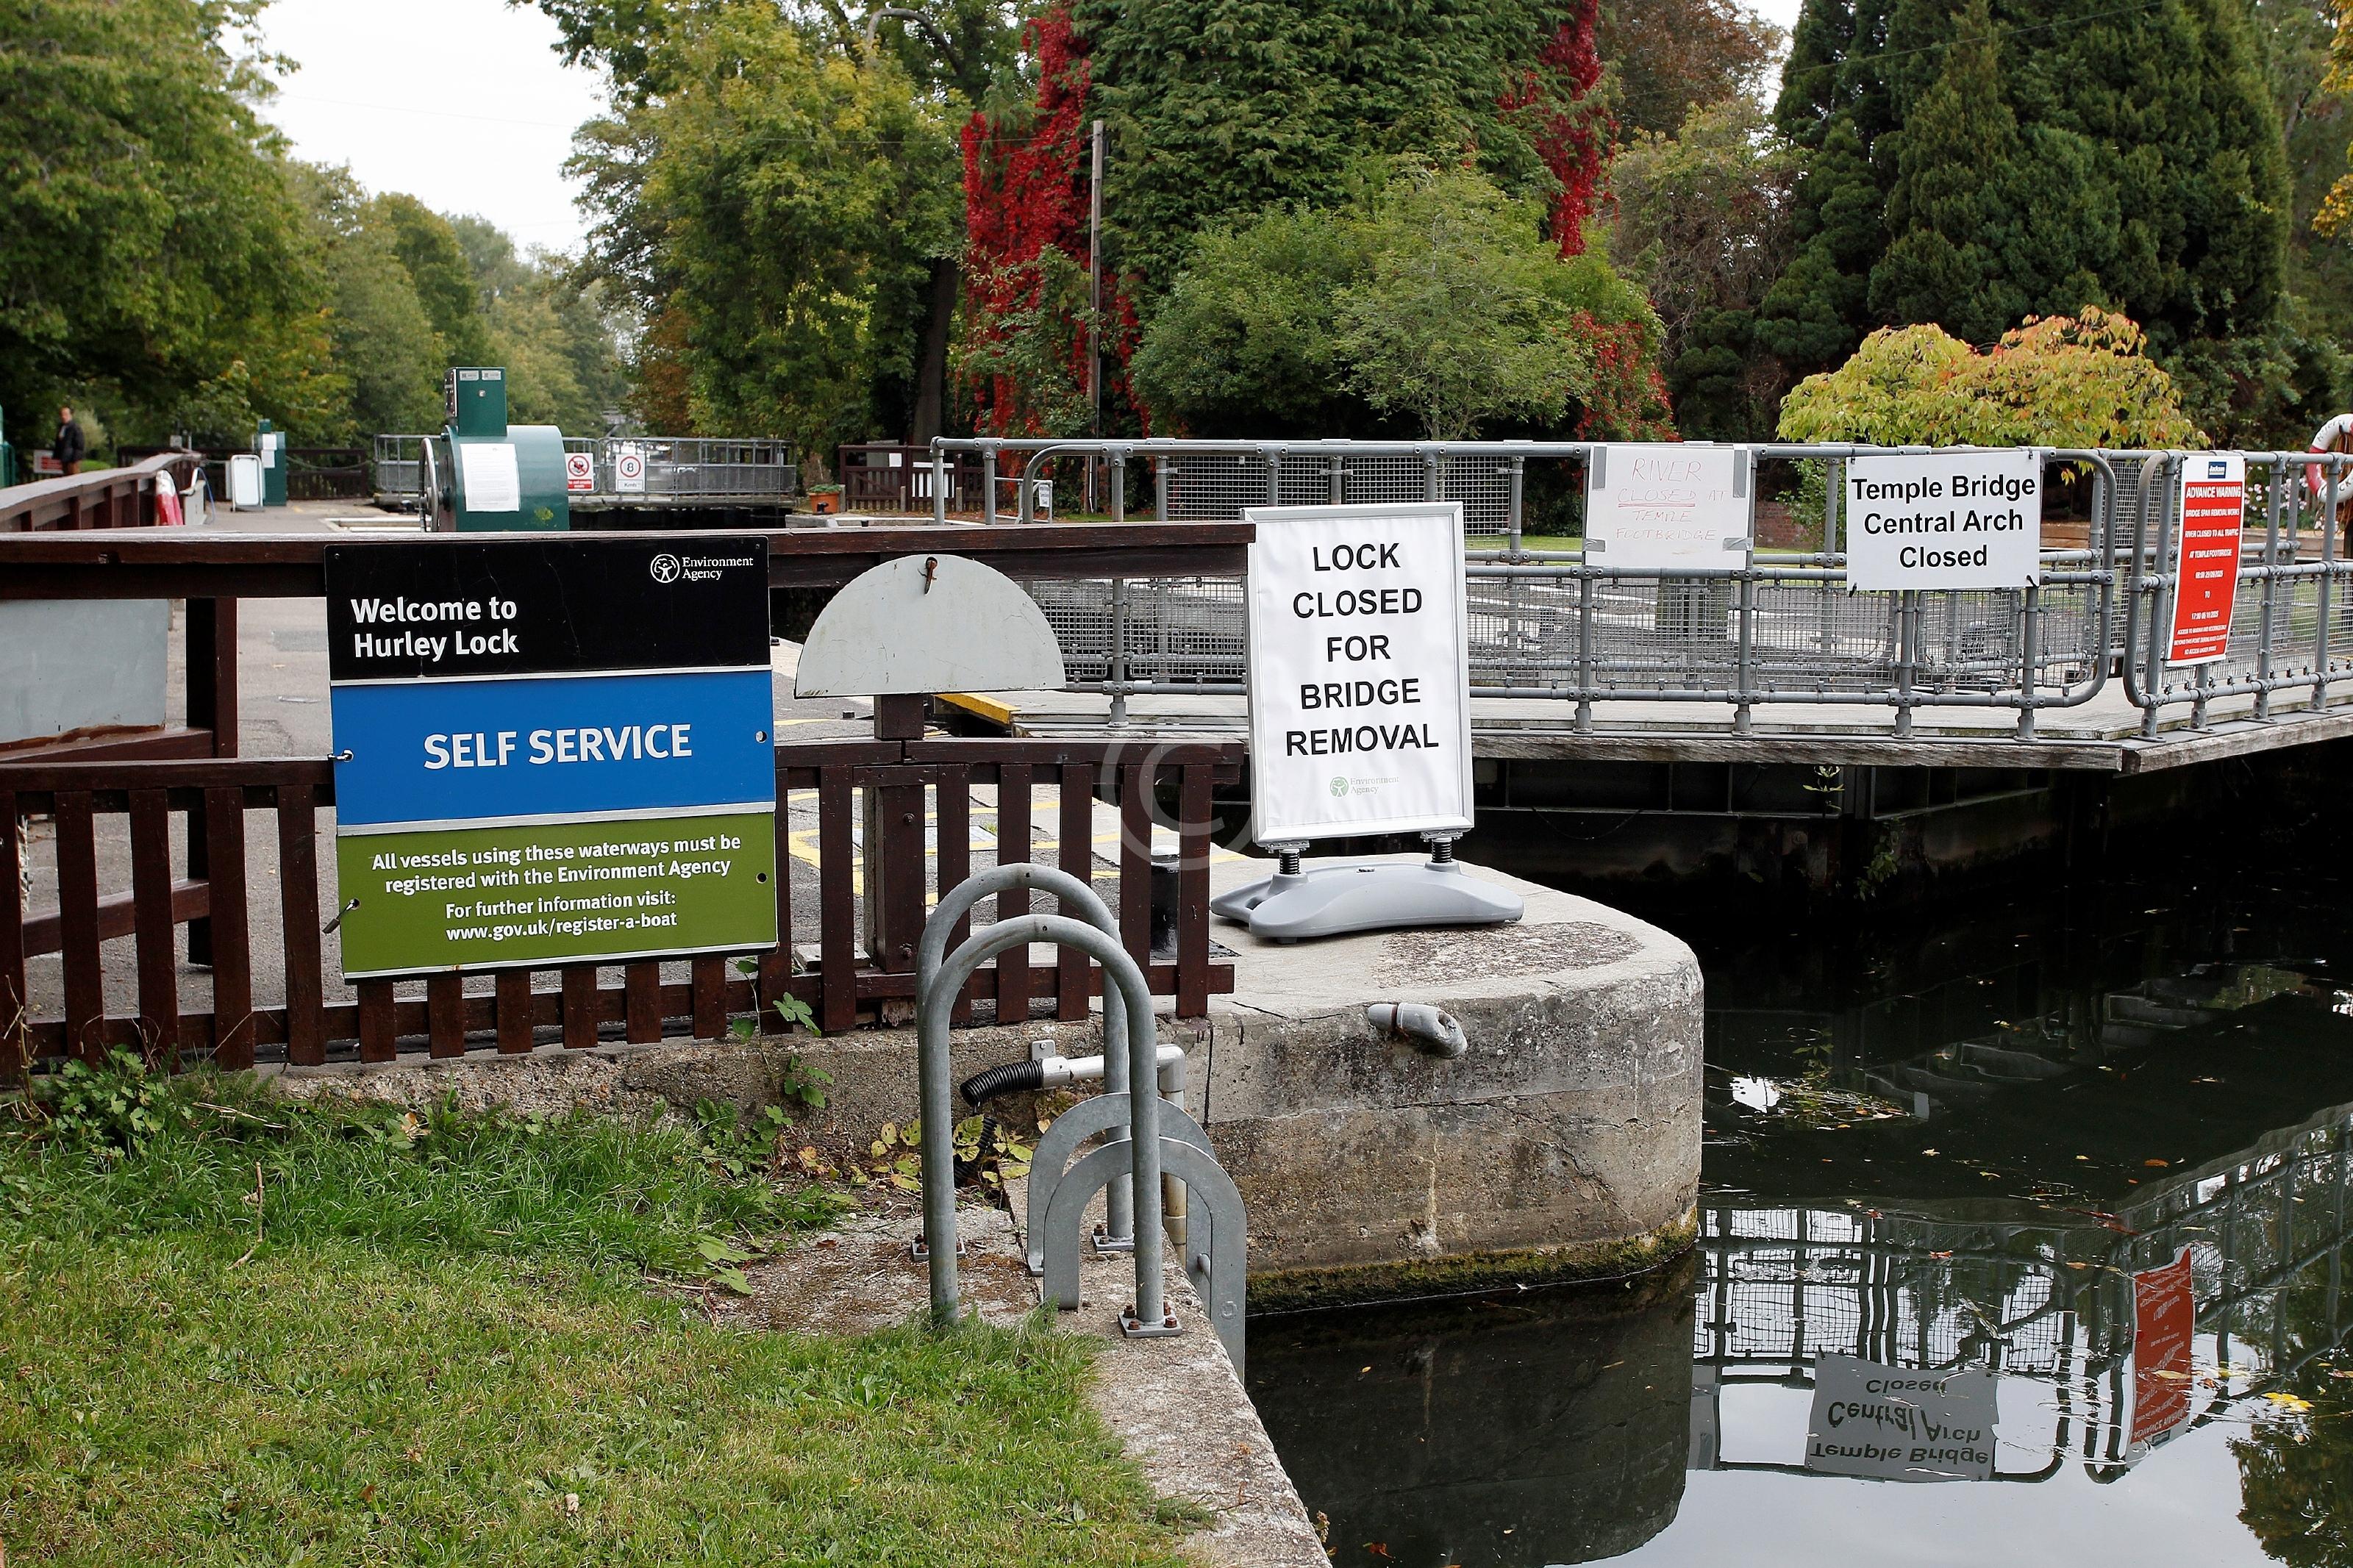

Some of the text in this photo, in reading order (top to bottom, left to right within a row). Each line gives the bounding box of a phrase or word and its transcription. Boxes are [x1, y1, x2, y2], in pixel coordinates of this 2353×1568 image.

[626, 462, 634, 472] 8
[1632, 457, 1702, 482] RIVER
[1618, 488, 1729, 503] CLOSED AT
[1851, 473, 2035, 504] Temple Bridge
[2185, 486, 2241, 498] ADVANCE WARNING
[1616, 527, 1718, 540] FOOTBRIDGE
[1864, 509, 2023, 534] Central Arch
[2197, 529, 2212, 537] CLOSED
[2212, 529, 2218, 537] TO
[2224, 528, 2239, 537] TRAFFIC
[682, 556, 754, 568] Environment
[1313, 543, 1401, 572] LOCK
[1899, 544, 1987, 568] Closed
[682, 568, 723, 581] Agency
[1293, 588, 1422, 619] CLOSED
[2204, 590, 2210, 598] TO
[351, 596, 517, 623] Welcome to
[354, 628, 520, 662] Hurley Lock
[1327, 634, 1391, 662] FOR
[1301, 678, 1421, 709] BRIDGE
[424, 724, 692, 770] SELF SERVICE
[1286, 723, 1439, 756] REMOVAL
[1350, 776, 1400, 785] Environment
[1350, 786, 1379, 795] Agency
[372, 834, 741, 870] All vessels using these waterways must be
[385, 859, 732, 896] registered with the Environment Agency
[446, 889, 677, 919] For further information visit:
[446, 912, 677, 941] www.gov.uk/register-a-boat
